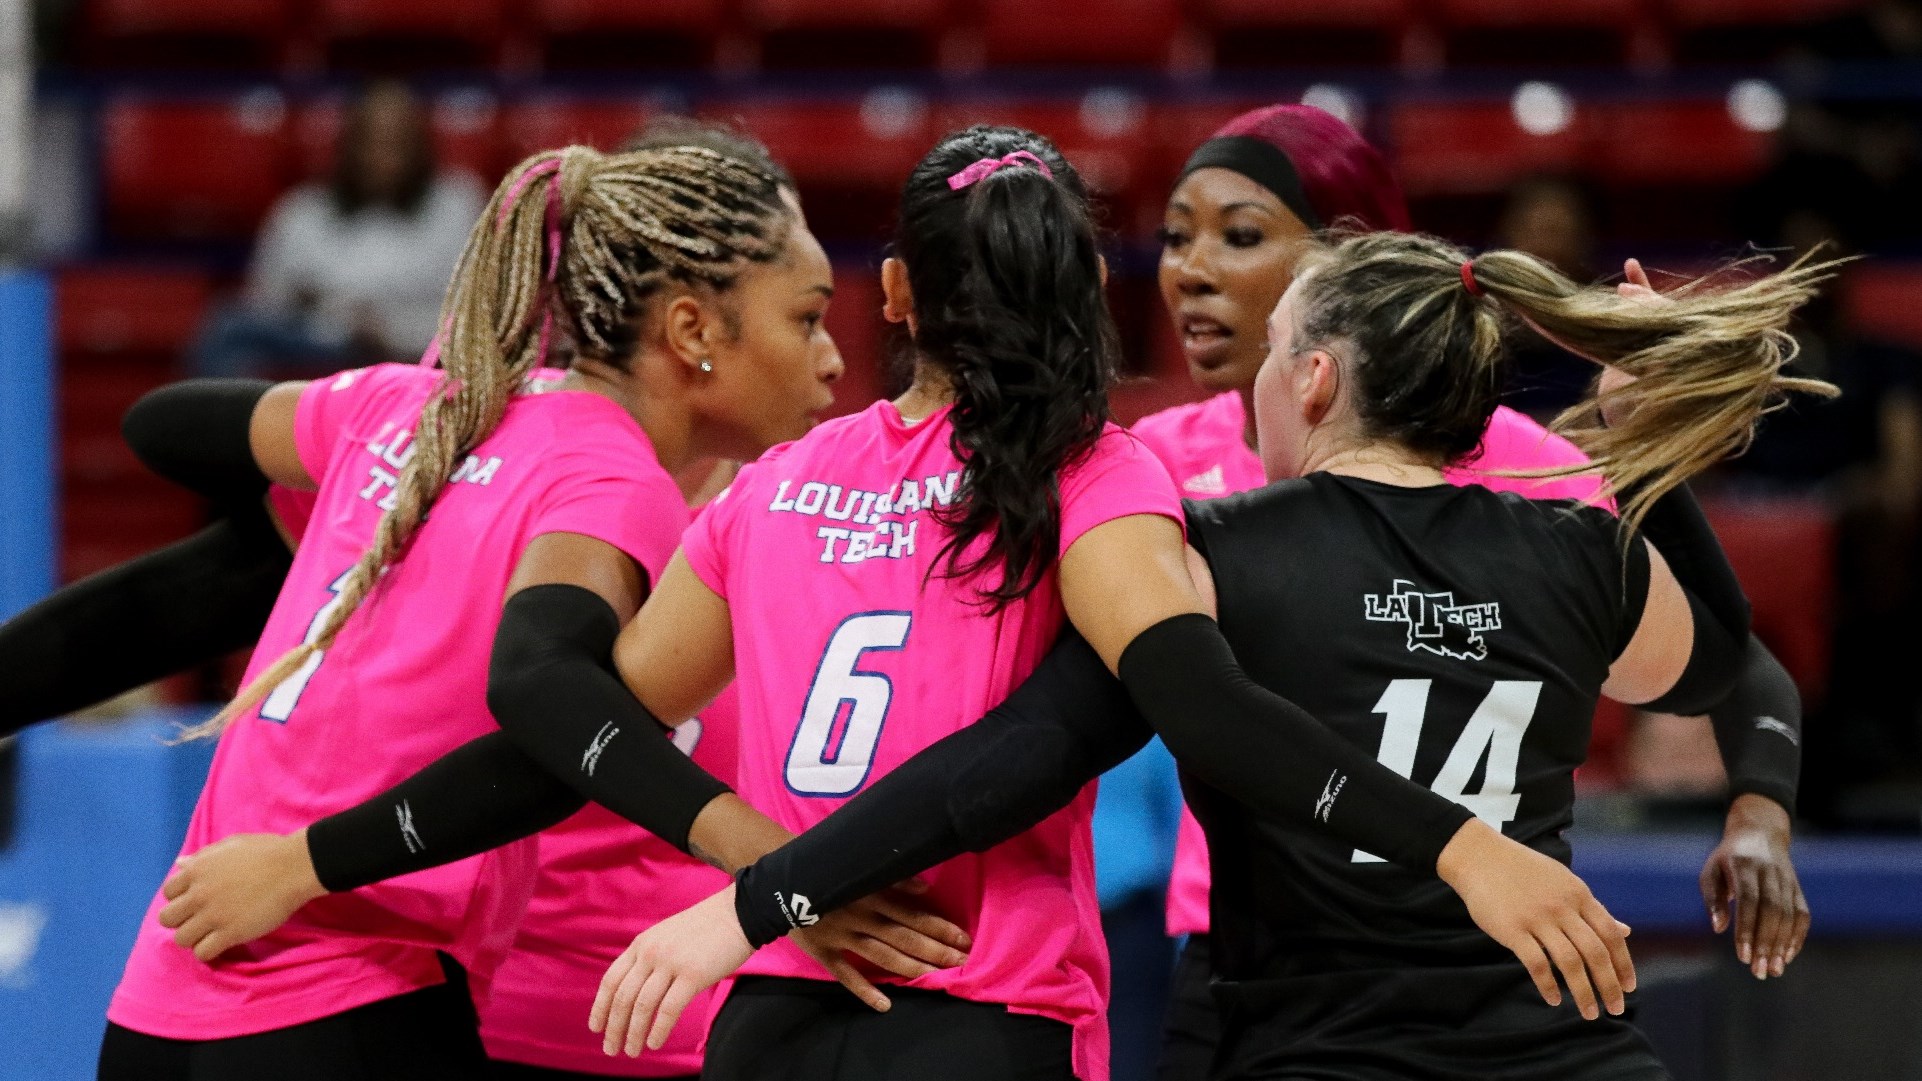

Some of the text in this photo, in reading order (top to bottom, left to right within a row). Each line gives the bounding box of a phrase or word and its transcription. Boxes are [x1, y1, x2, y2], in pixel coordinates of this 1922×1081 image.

[817, 519, 918, 563] TECH
[782, 610, 912, 798] 6
[1351, 679, 1543, 863] 14
